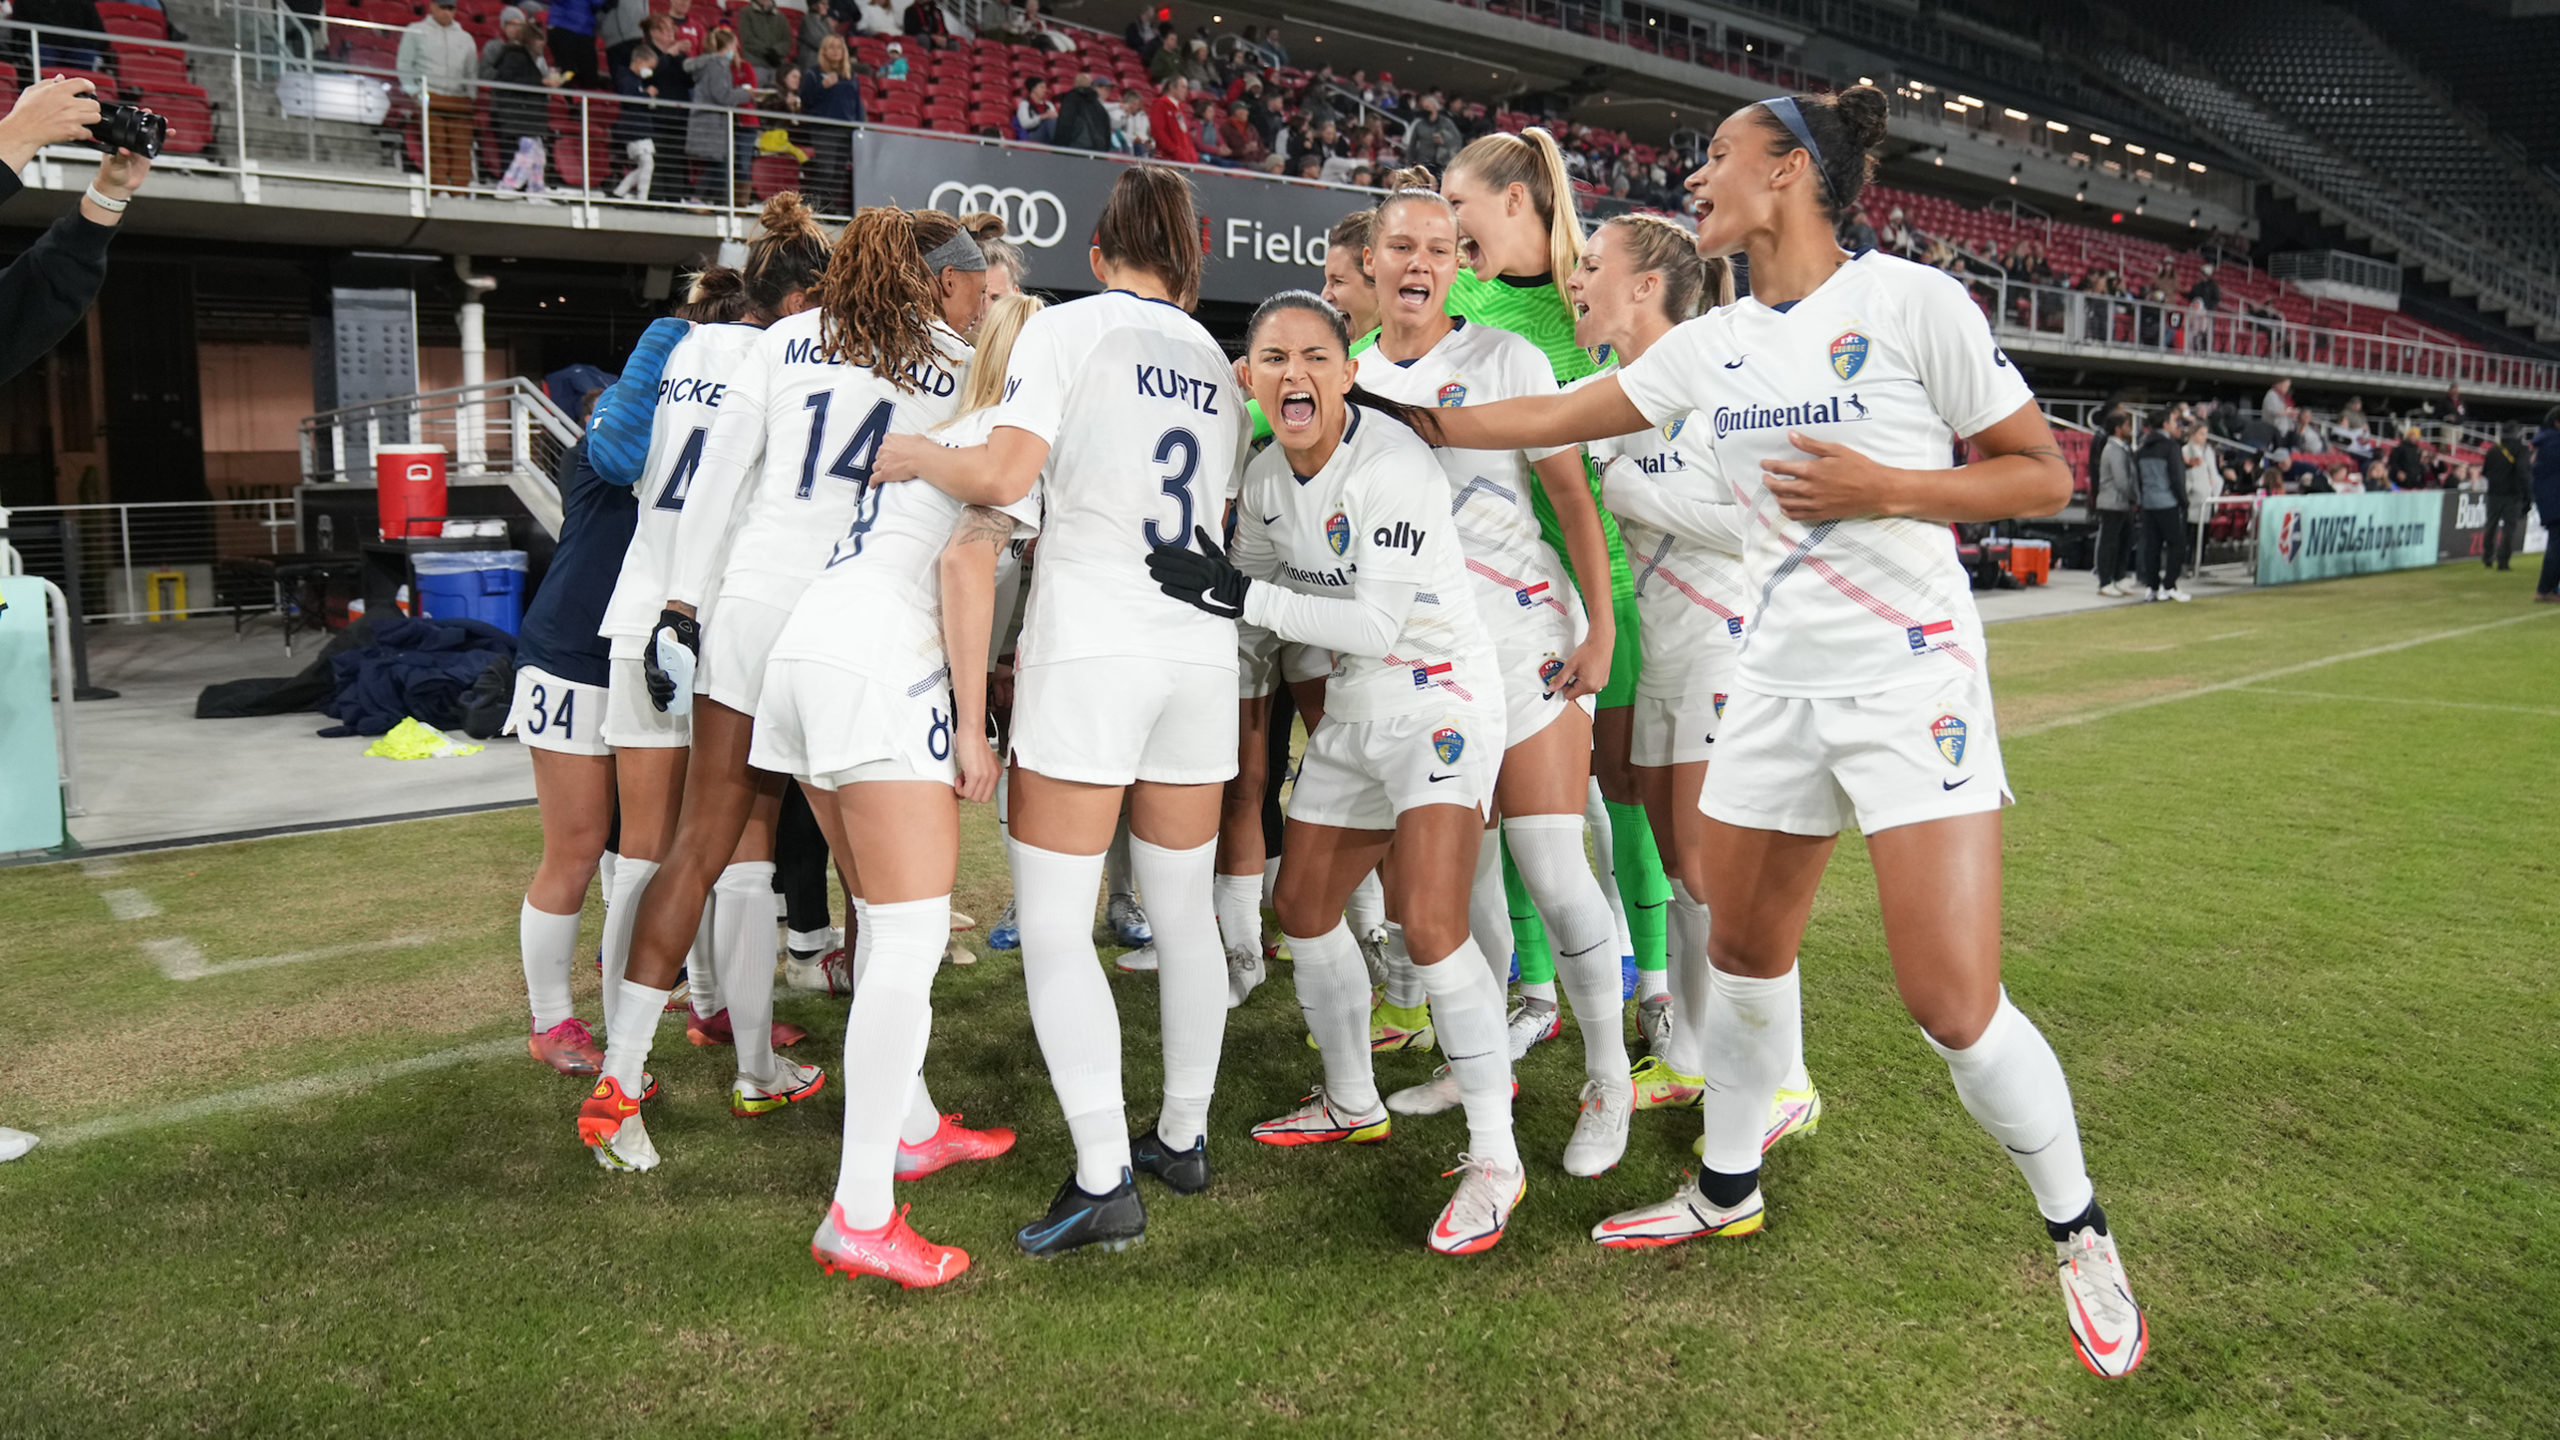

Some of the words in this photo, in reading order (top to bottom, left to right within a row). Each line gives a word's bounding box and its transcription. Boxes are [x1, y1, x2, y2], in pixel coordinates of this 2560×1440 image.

[1227, 217, 1330, 267] Field
[1136, 364, 1219, 416] KURTZ
[1713, 396, 1843, 440] Continental
[794, 387, 897, 508] 14
[1141, 426, 1202, 552] 3
[1373, 520, 1426, 558] ally
[2305, 514, 2426, 560] NWSLshop.com
[527, 683, 576, 741] 34
[926, 705, 951, 761] 8
[839, 1234, 891, 1274] ULTRA
